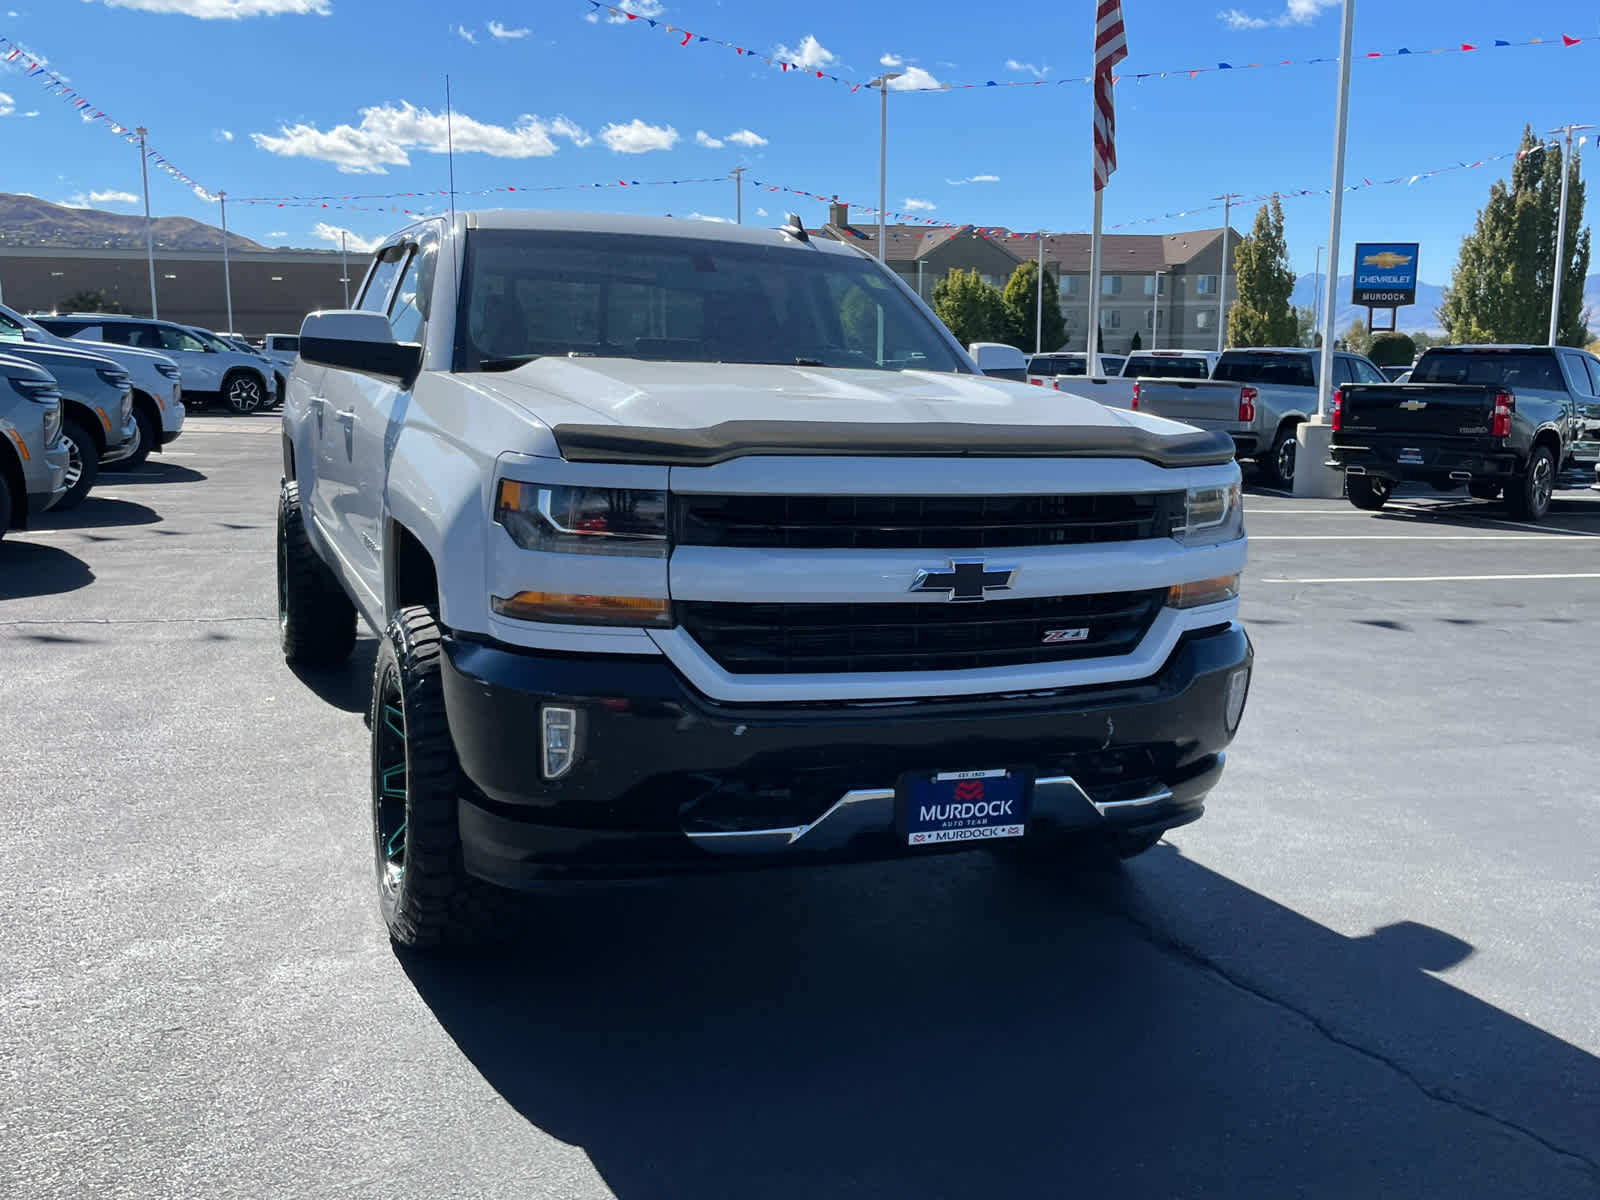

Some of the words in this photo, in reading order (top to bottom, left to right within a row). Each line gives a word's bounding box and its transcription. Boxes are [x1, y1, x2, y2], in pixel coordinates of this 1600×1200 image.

[1359, 275, 1410, 284] CHEVROLET
[1362, 292, 1405, 301] MURDOCK
[919, 799, 1014, 822] MURDOCK
[942, 820, 964, 828] AUTO
[967, 818, 988, 826] TEAM
[935, 827, 998, 841] MURDOCK
